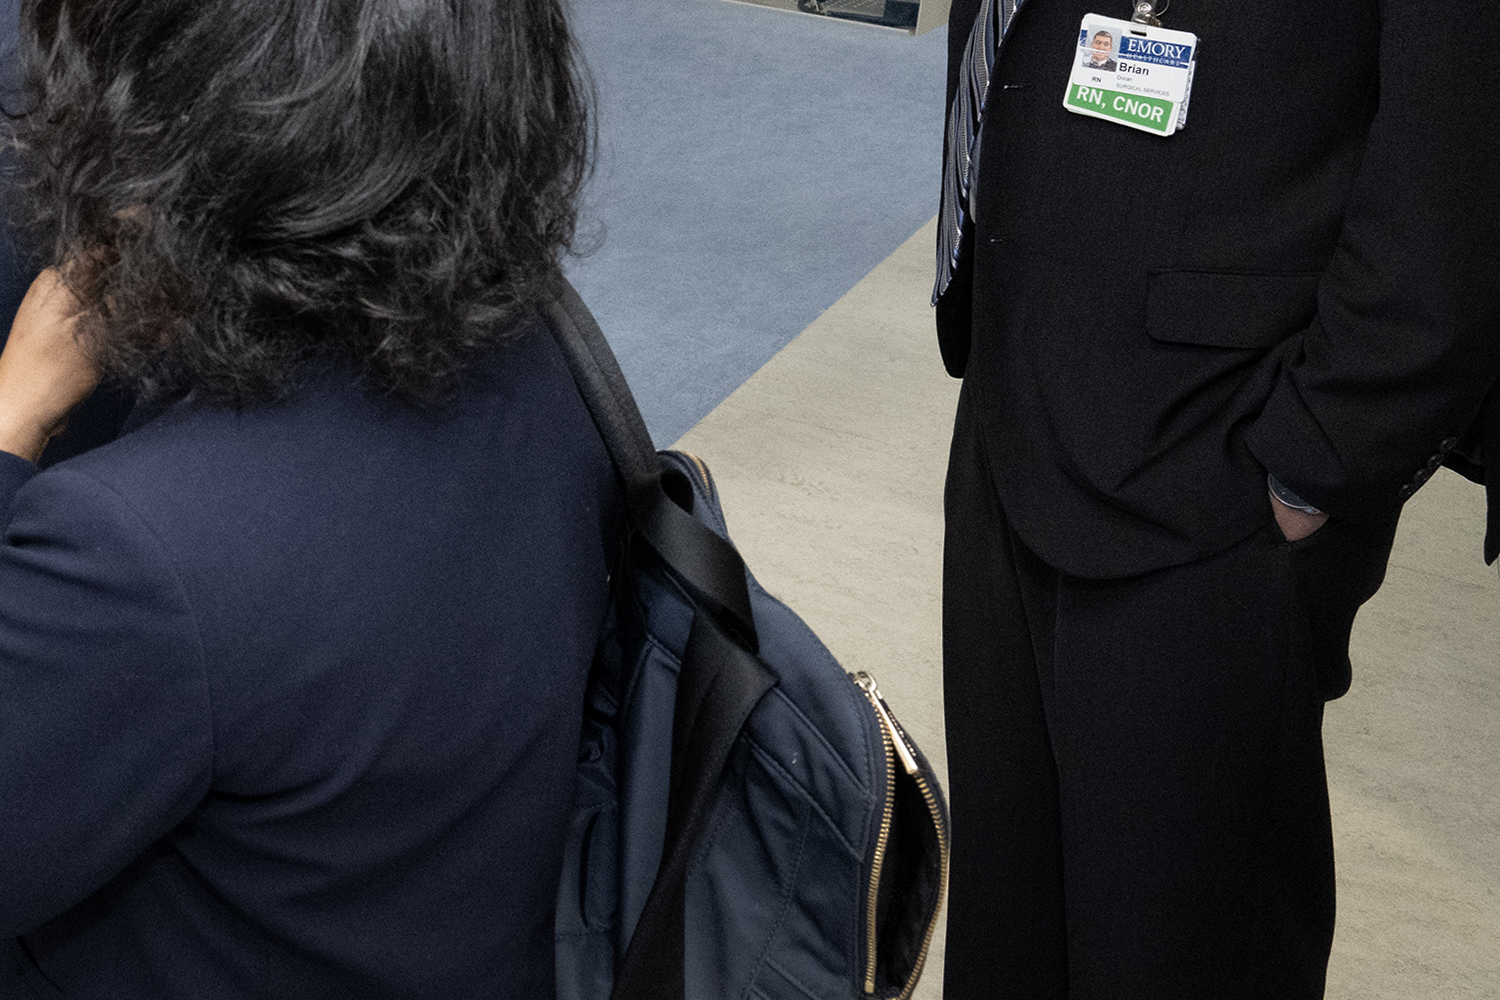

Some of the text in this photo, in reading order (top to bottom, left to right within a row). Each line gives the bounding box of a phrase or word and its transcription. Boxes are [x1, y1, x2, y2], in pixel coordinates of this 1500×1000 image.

[1128, 39, 1186, 59] EMORY
[1119, 62, 1150, 76] Brian
[1076, 86, 1164, 122] RN, CNOR
